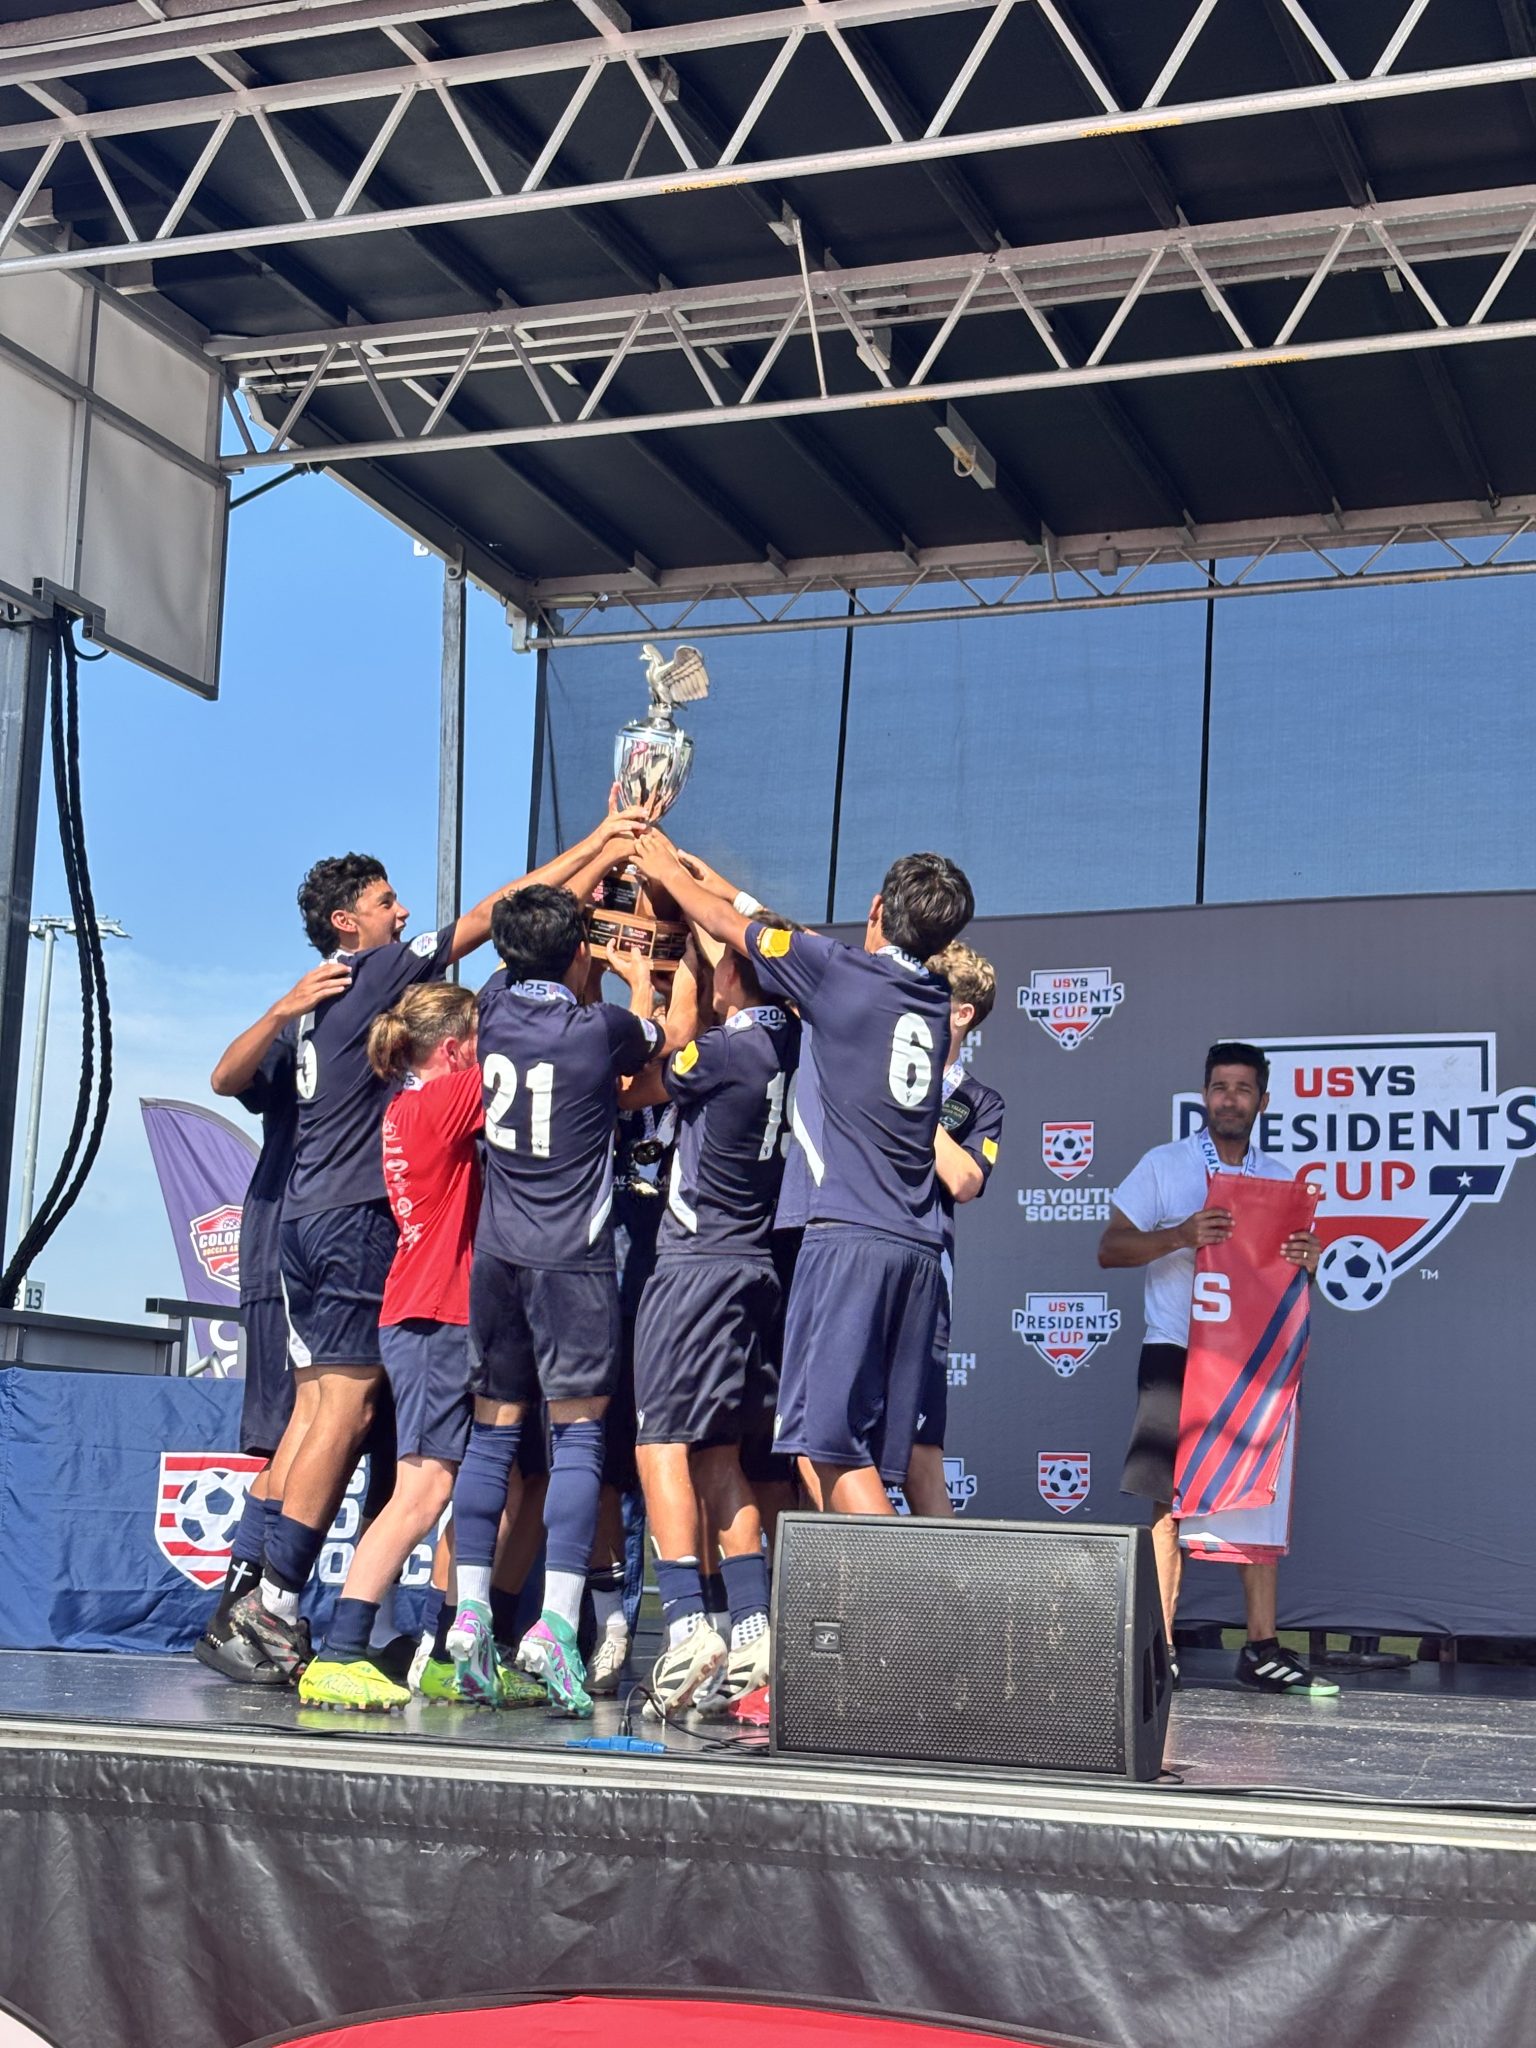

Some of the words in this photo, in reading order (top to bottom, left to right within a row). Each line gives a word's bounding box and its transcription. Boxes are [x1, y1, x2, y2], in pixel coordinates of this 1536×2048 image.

[1053, 977, 1088, 988] USYS
[1020, 985, 1122, 1006] PRESIDENTS
[1053, 1005, 1088, 1019] CUP
[888, 1012, 934, 1108] 6
[1294, 1065, 1416, 1098] USYS
[483, 1053, 554, 1158] 21
[1180, 1094, 1536, 1152] PESIDENTS
[1025, 1204, 1111, 1222] SOCCER
[1420, 1268, 1438, 1280] TM
[1048, 1302, 1085, 1312] USYS
[1014, 1311, 1119, 1330] PRESIDENTS
[1048, 1331, 1084, 1344] CUP
